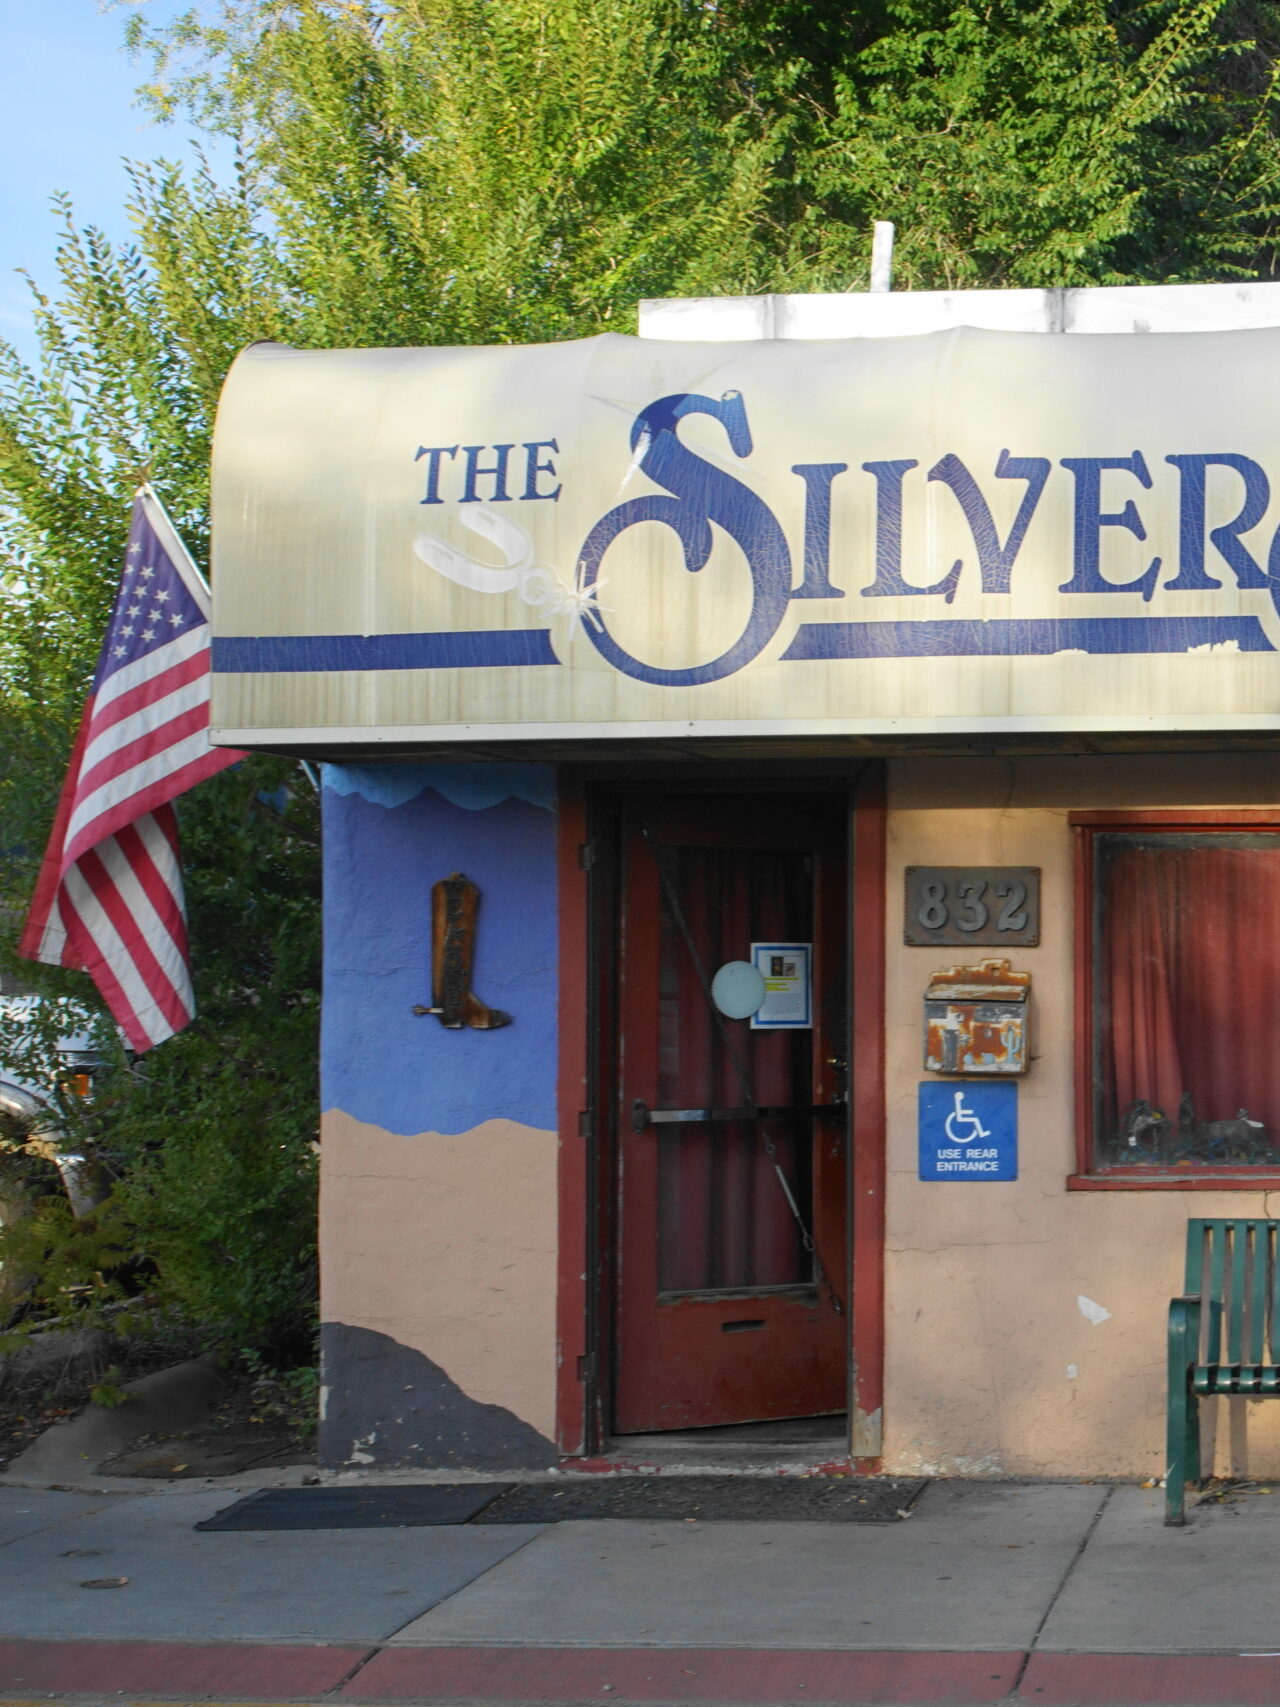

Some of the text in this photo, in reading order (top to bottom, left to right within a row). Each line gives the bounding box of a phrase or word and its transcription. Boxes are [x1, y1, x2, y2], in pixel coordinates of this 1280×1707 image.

[414, 438, 563, 504] THE
[918, 879, 1029, 933] 832
[936, 1161, 999, 1172] ENTRANCE
[937, 1149, 998, 1159] USE REAR
